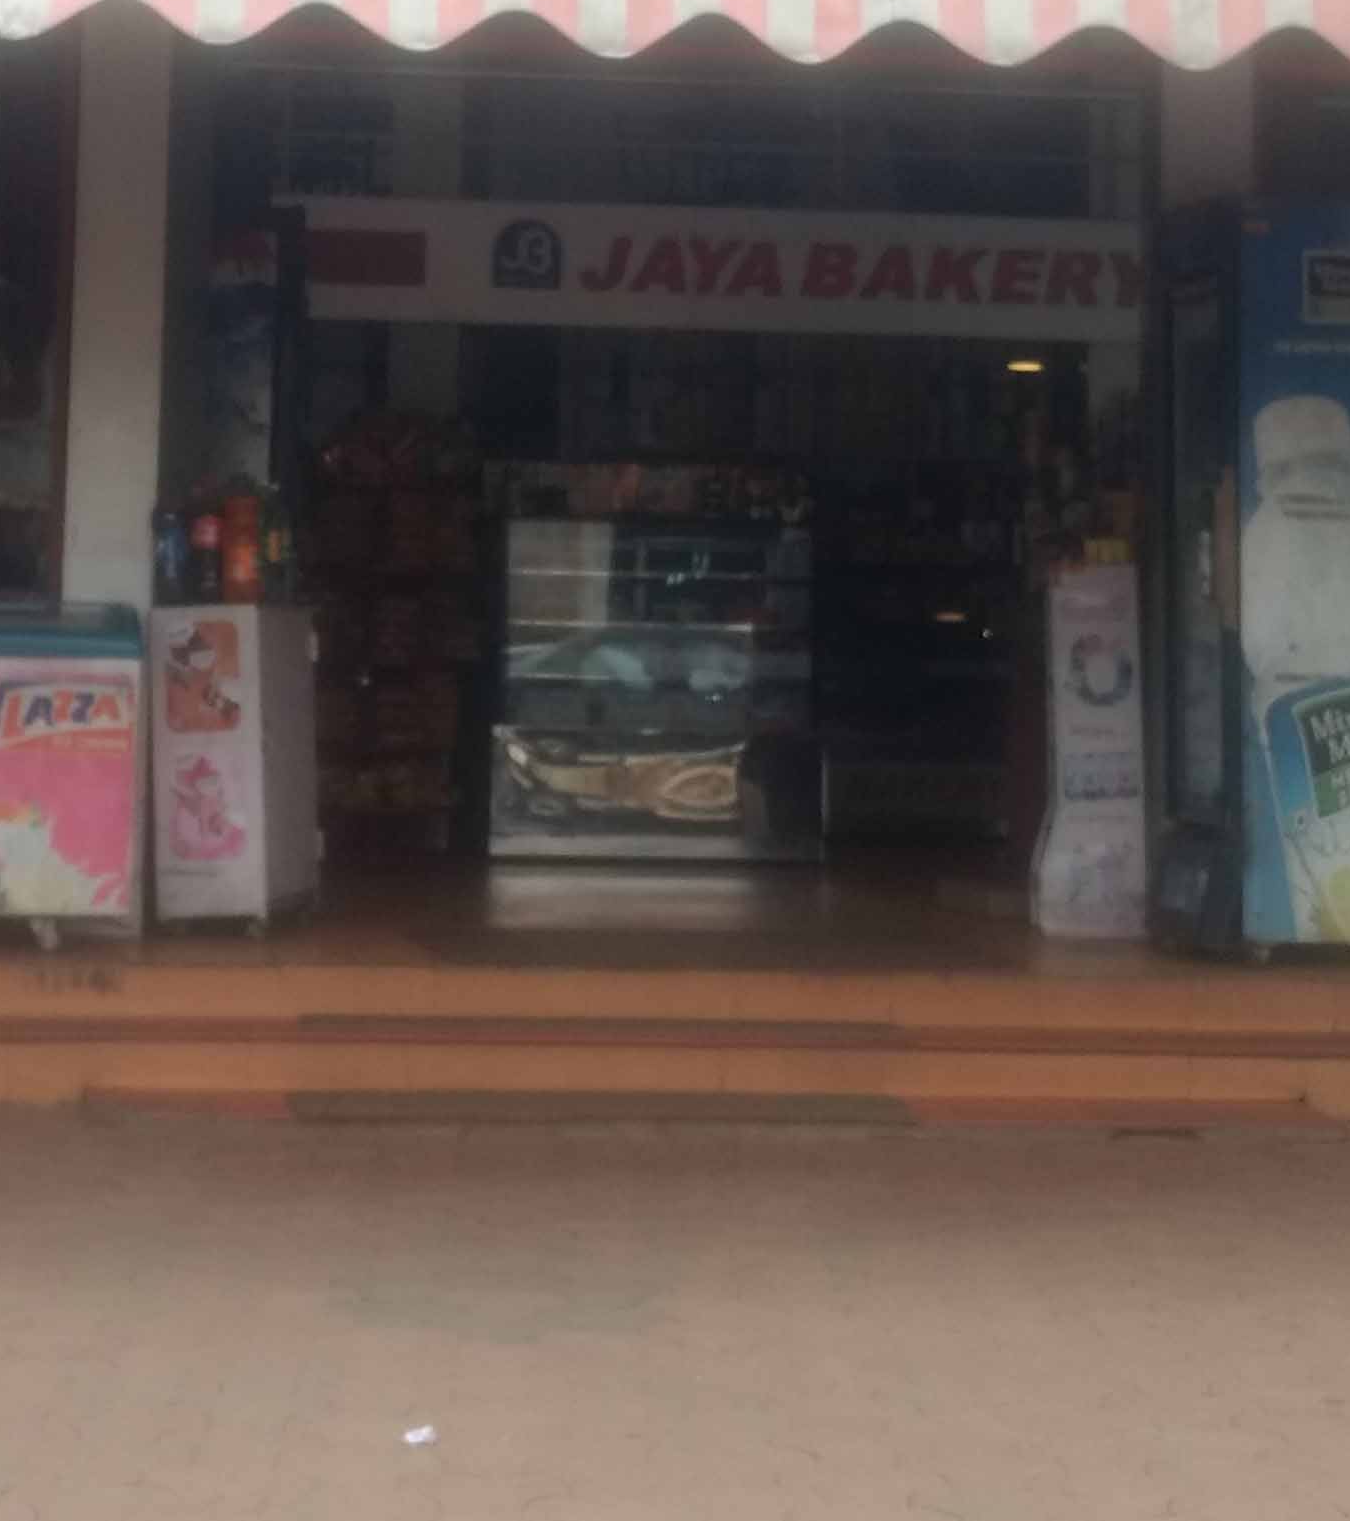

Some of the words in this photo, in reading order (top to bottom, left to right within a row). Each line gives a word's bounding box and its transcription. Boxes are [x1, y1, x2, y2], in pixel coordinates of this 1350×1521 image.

[578, 235, 785, 297] JAYA
[799, 241, 1146, 309] BAKERY
[3, 688, 122, 738] LAZZA
